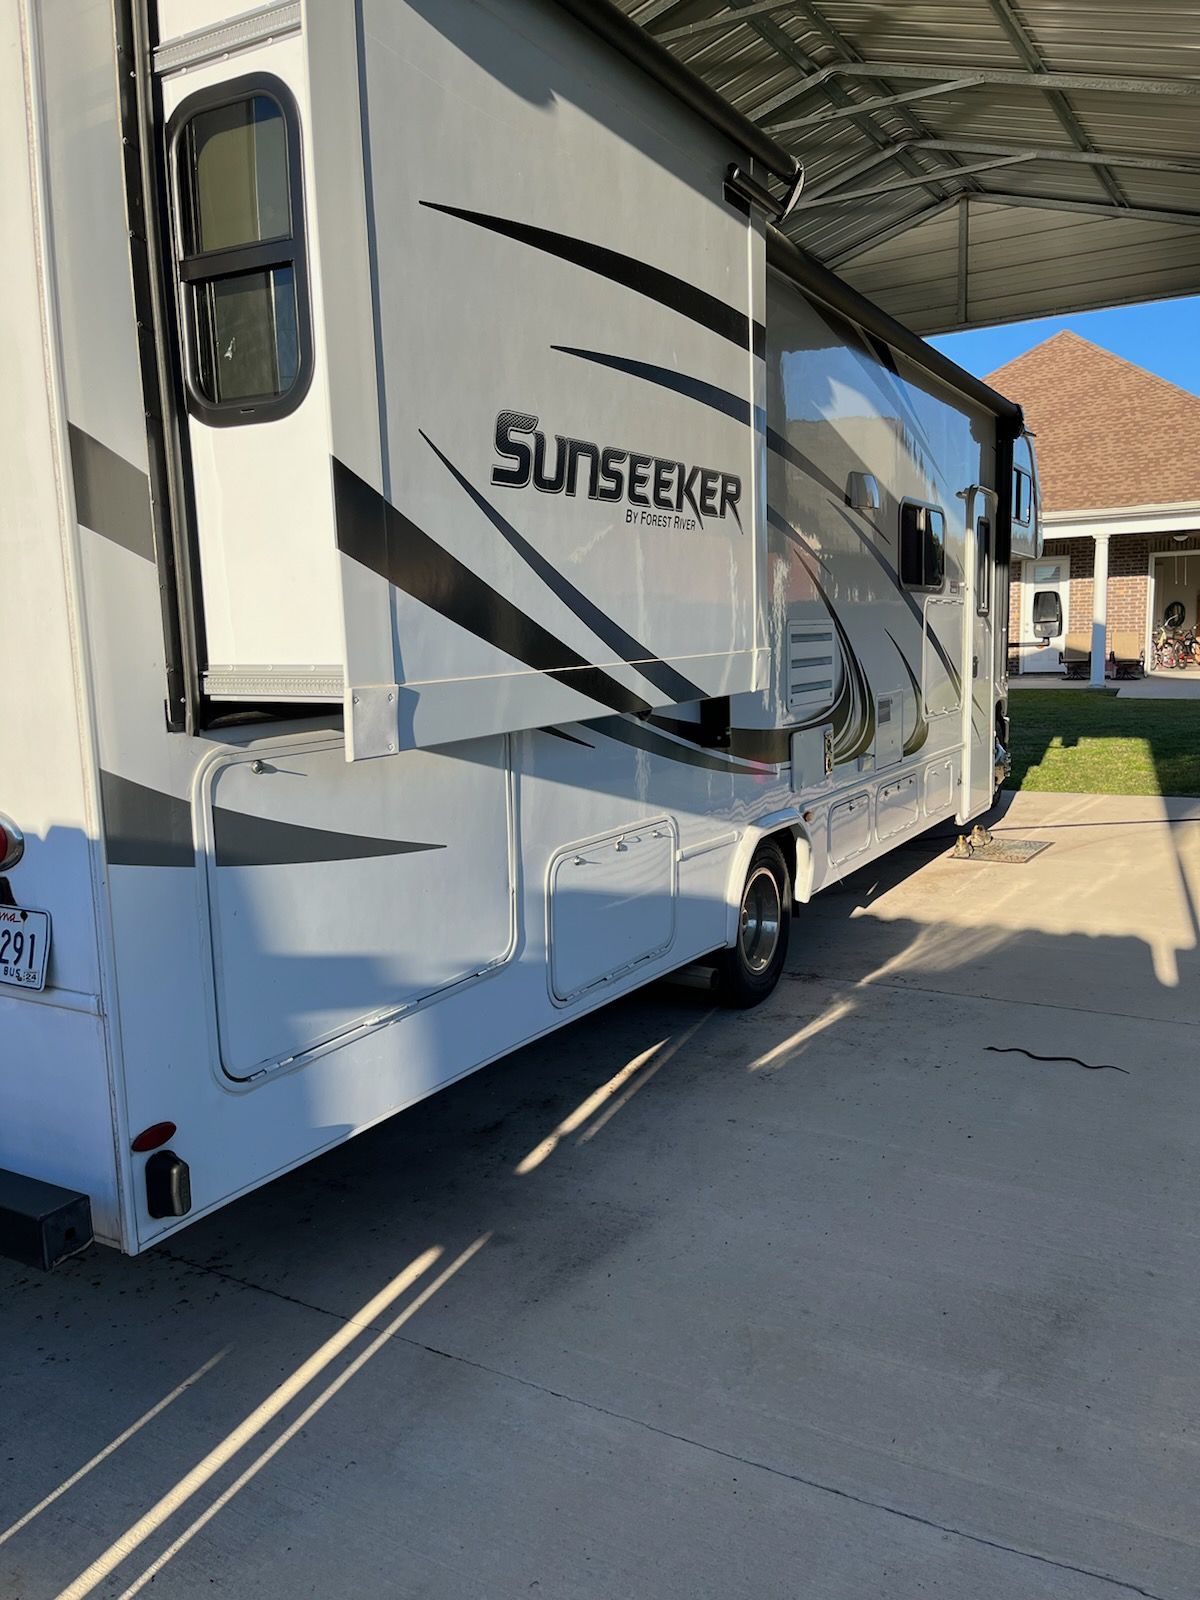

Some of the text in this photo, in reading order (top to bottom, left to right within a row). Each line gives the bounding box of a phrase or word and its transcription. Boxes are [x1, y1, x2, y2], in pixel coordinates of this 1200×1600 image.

[625, 509, 697, 531] BY FOREST RIVER
[0, 929, 35, 969] 291
[3, 967, 21, 978] BUS
